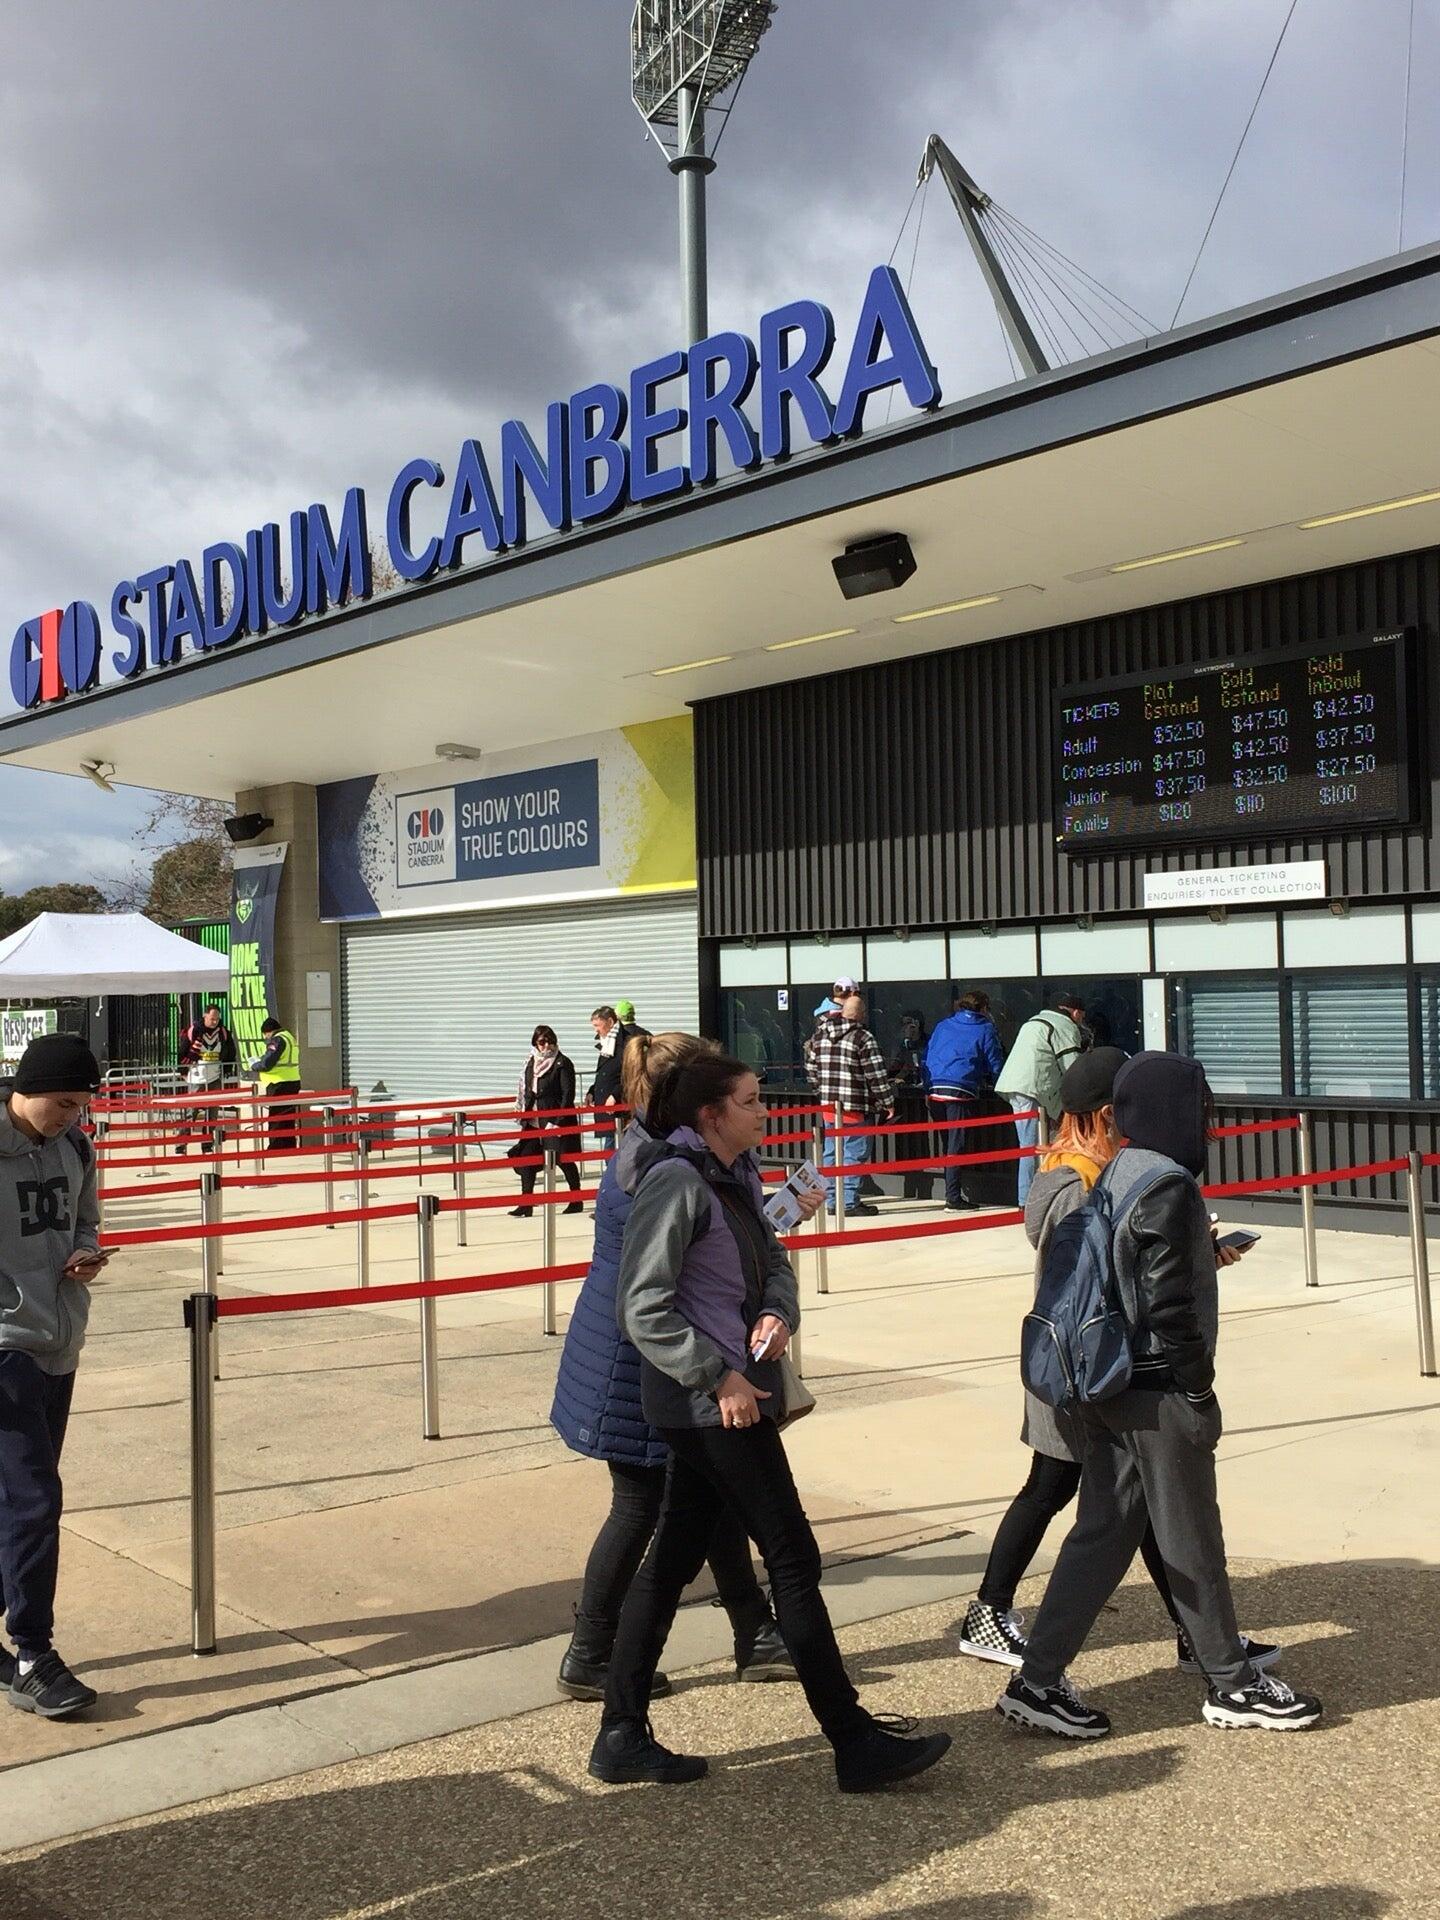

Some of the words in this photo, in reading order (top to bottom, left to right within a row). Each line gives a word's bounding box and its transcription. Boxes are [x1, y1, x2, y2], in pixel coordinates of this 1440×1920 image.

[10, 600, 101, 708] GIO
[111, 487, 372, 678] STADIUM
[387, 265, 942, 582] CANBERRA
[1373, 633, 1402, 643] GALAXY
[1308, 653, 1344, 675] Gold
[1144, 681, 1174, 701] Plat
[1221, 668, 1254, 689] Gold
[1308, 670, 1361, 695] InBowl
[1144, 695, 1199, 720] Gstand
[1221, 682, 1281, 708] Gstand
[1063, 702, 1120, 724] TICKETS
[1063, 736, 1098, 757] Adult
[1153, 721, 1205, 744] $52.50
[1232, 709, 1288, 733] $47.50
[1313, 693, 1374, 719] $42.50
[1062, 757, 1142, 781] Concession
[1153, 749, 1206, 772] $47.50
[1232, 735, 1289, 759] $42.50
[1316, 724, 1375, 748] $37.50
[1065, 788, 1109, 807] Junior
[1155, 775, 1206, 796] $37.50
[1233, 765, 1288, 788] $32.50
[1316, 754, 1376, 778] $27.50
[462, 797, 510, 828] SHOW
[514, 789, 560, 820] YOUR
[1064, 815, 1109, 833] Family
[1159, 802, 1192, 821] $120
[1235, 794, 1265, 814] $110
[1319, 784, 1357, 805] $100
[407, 808, 444, 839] GIO
[408, 839, 445, 856] STADIUM
[462, 832, 503, 861] TRUE
[508, 819, 588, 857] COLOURS
[408, 854, 445, 868] CANBERRA
[1177, 876, 1225, 887] GENERAL
[1230, 870, 1287, 882] TICKETING
[1210, 887, 1247, 897] TICKET
[1250, 882, 1322, 895] COLLECTION
[231, 942, 259, 975] HOME
[231, 976, 243, 1007] OF
[245, 975, 267, 1007] THE
